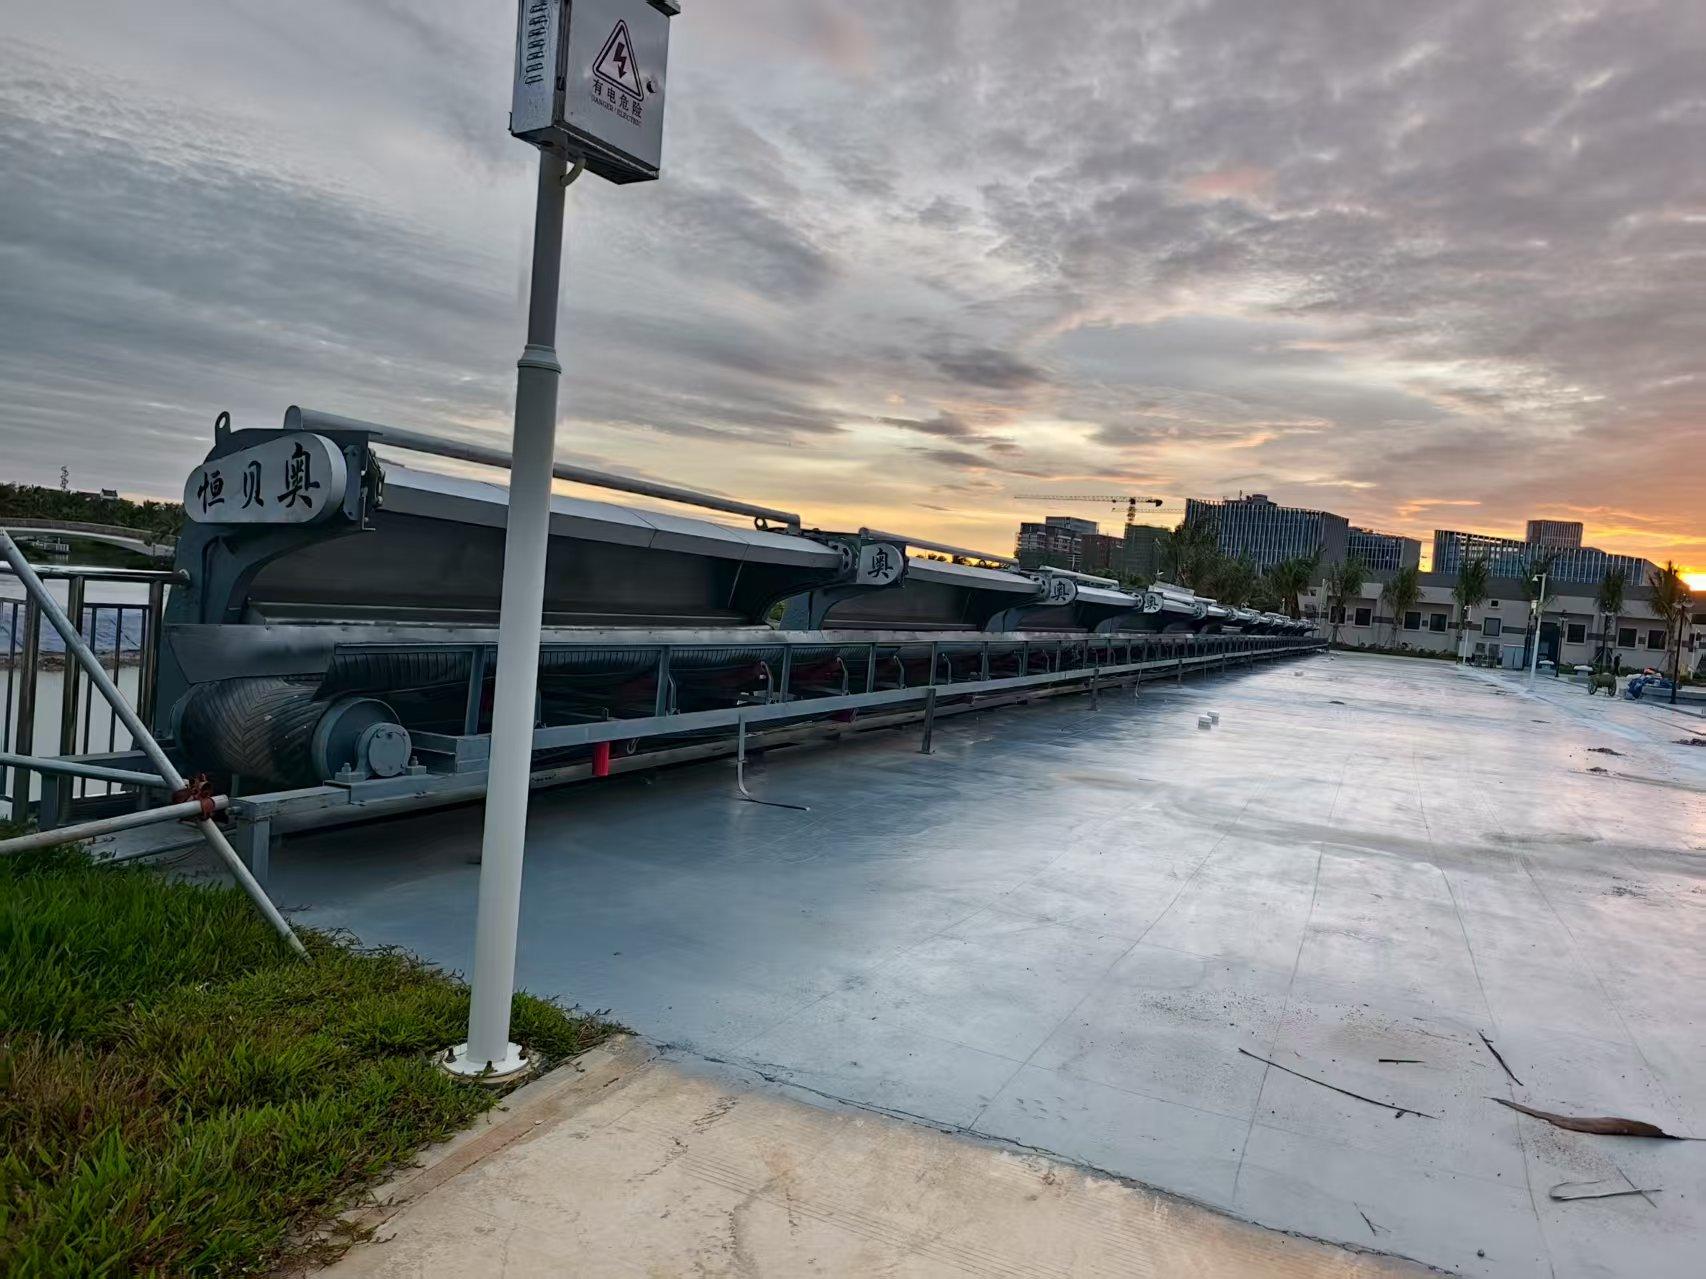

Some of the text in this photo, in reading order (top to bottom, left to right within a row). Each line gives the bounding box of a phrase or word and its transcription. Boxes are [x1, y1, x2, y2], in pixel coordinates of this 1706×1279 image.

[592, 79, 643, 119] 有电危险
[867, 547, 894, 579] 奥
